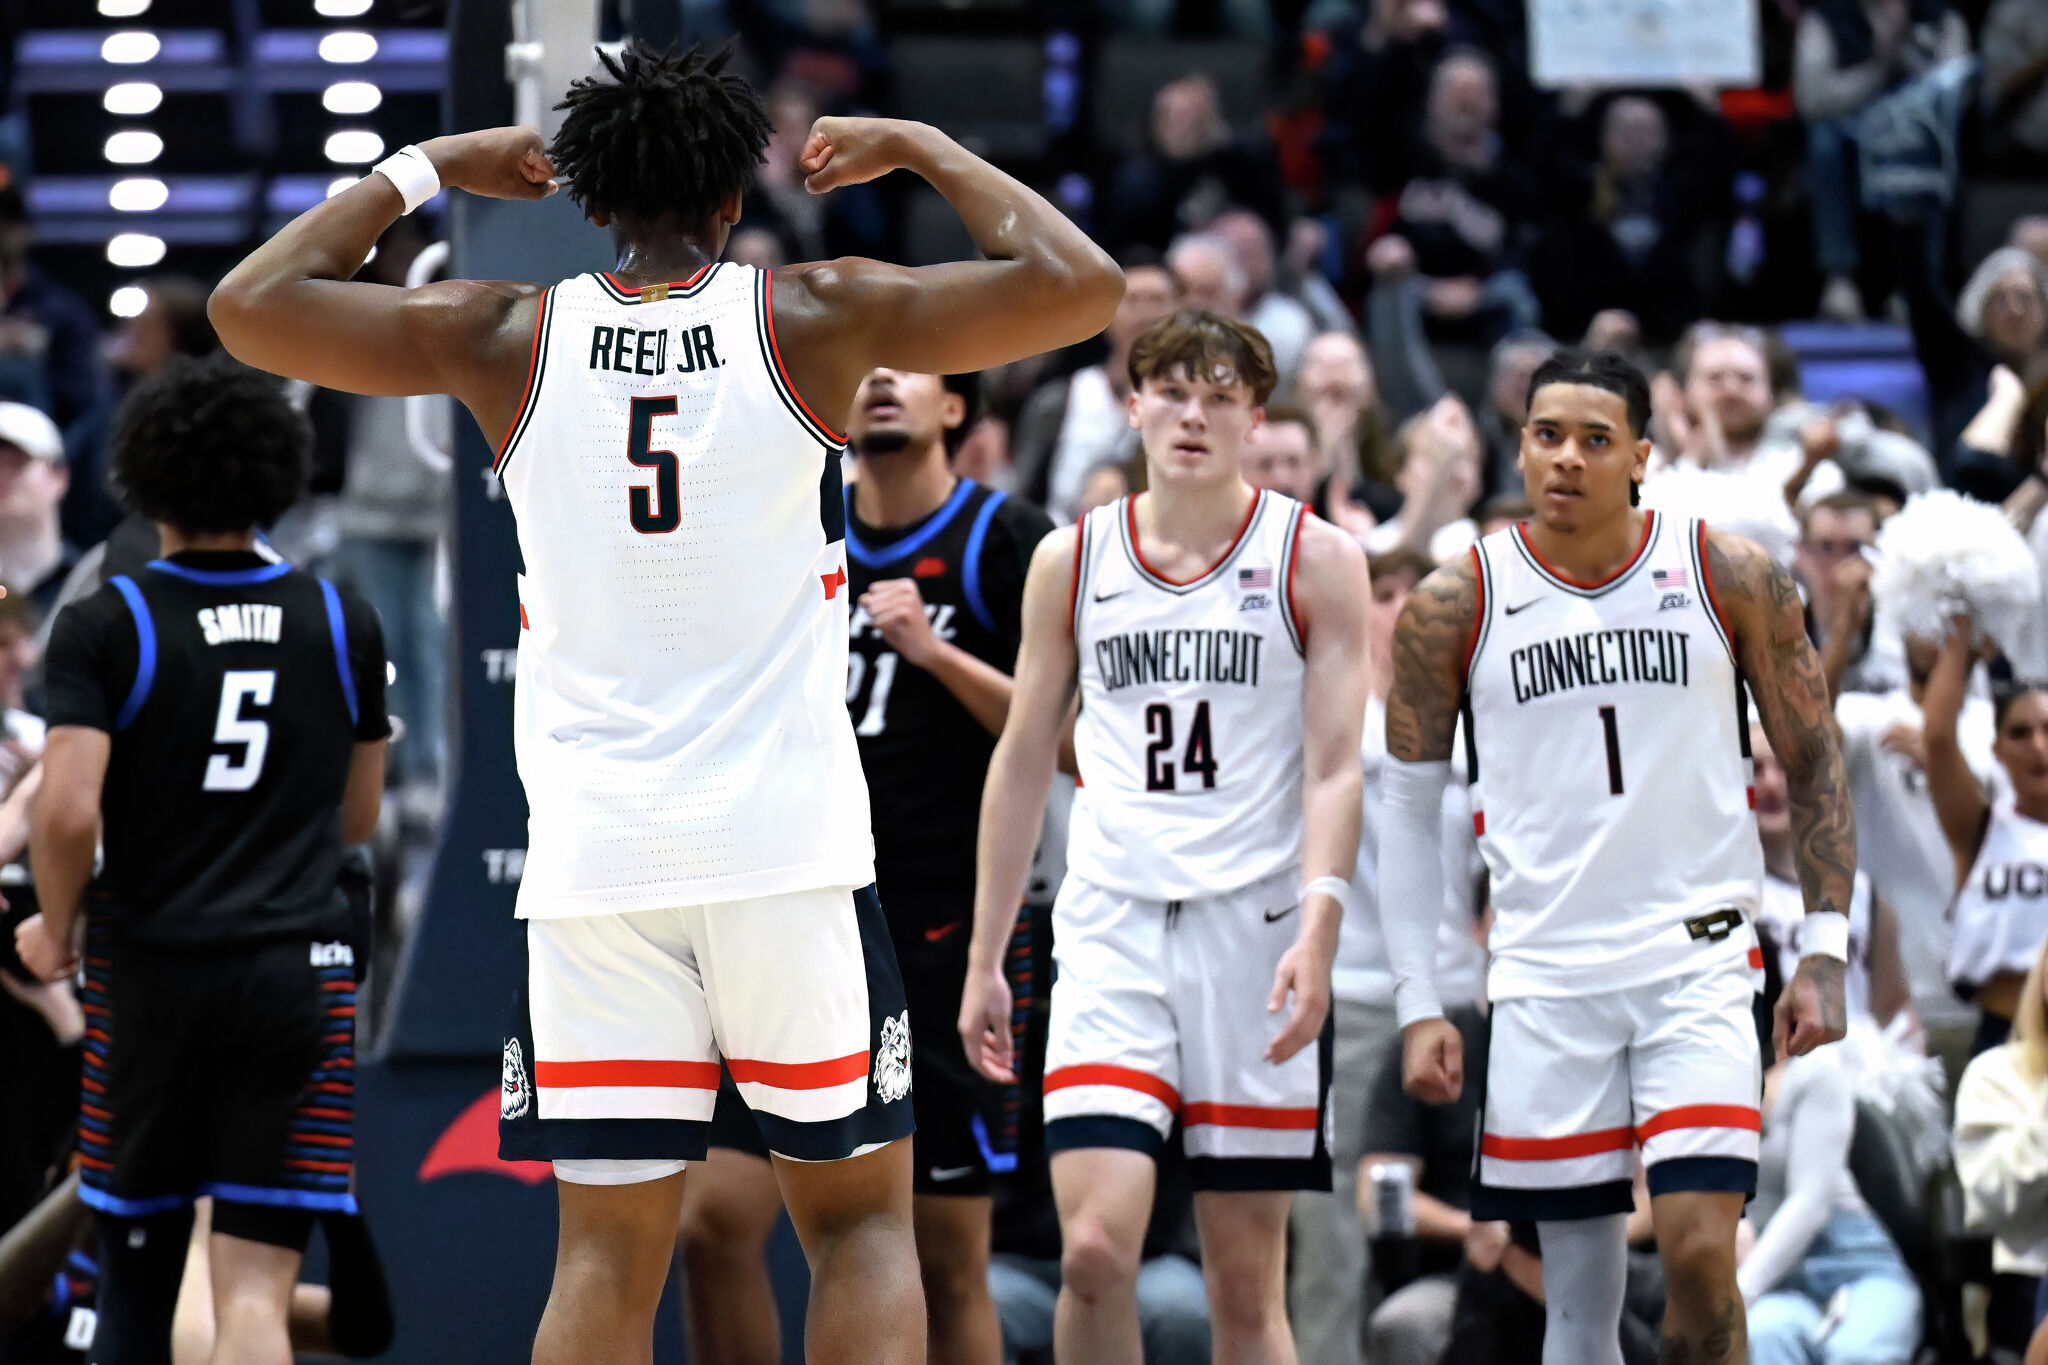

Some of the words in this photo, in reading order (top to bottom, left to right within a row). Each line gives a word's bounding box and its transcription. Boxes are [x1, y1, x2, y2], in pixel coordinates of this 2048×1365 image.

[589, 325, 668, 376] REED
[677, 324, 726, 374] JR.
[627, 395, 682, 534] 5
[197, 603, 283, 646] SMITH
[1095, 629, 1264, 692] CONNECTICUT
[1510, 628, 1690, 705] CONNECTICUT
[201, 669, 278, 791] 5
[1145, 699, 1218, 792] 24
[1598, 704, 1625, 796] 1
